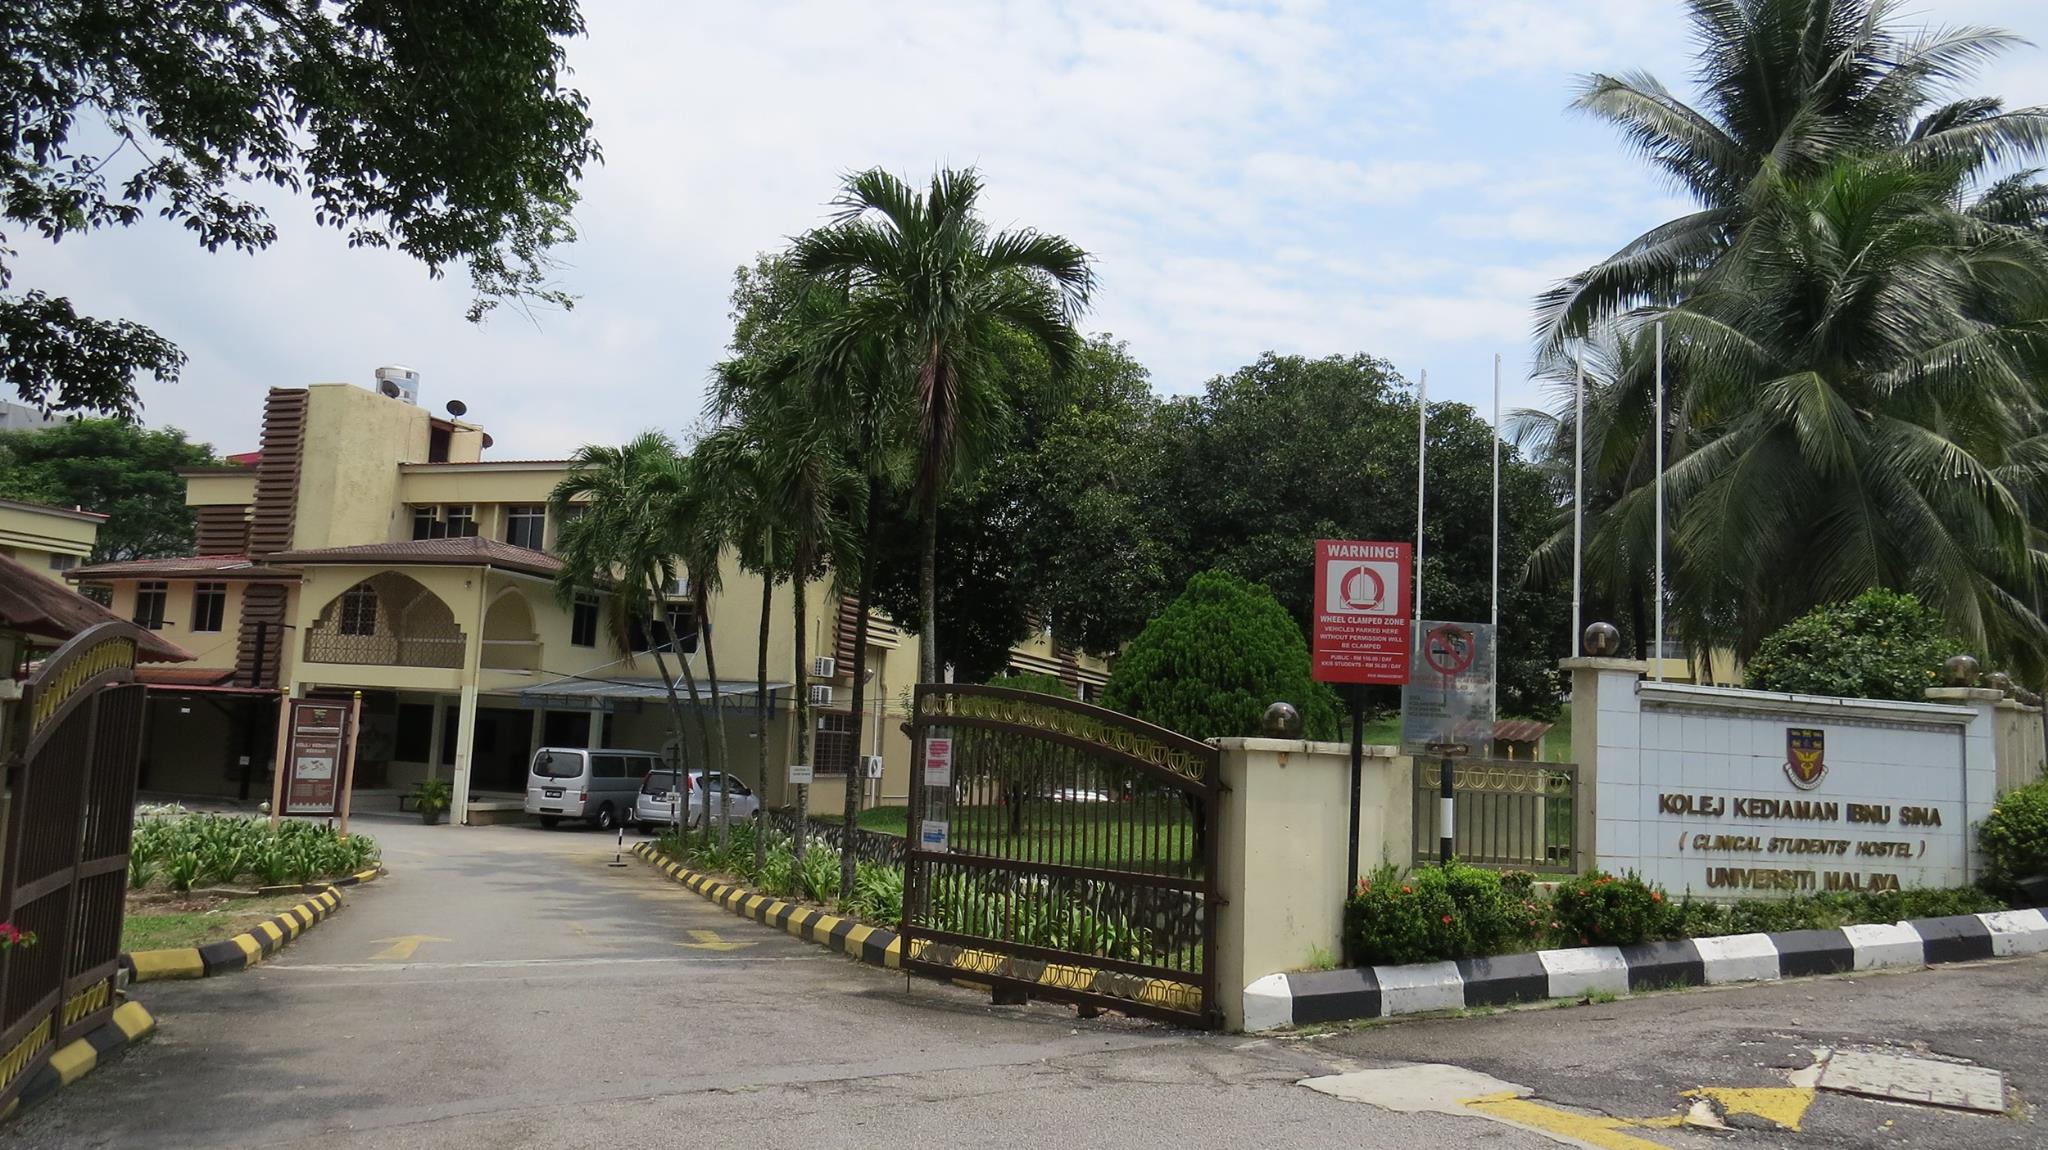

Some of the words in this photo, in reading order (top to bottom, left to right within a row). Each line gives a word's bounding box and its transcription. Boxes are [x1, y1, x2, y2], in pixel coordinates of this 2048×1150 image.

[1327, 545, 1399, 558] WARNING!
[1320, 615, 1346, 624] WHEEL
[1347, 616, 1382, 625] CLAMPED
[1384, 618, 1405, 626] ZONE
[1659, 794, 1725, 817] KOLEJ
[1733, 797, 1839, 821] KEDIAMAN
[1846, 803, 1891, 824] IBNU
[1898, 806, 1942, 827] SINA
[1693, 833, 1763, 852] CLINICAL
[1767, 837, 1851, 855] STUDENTS'
[1855, 841, 1913, 857] HOSTEL
[1706, 867, 1816, 890] UNIVERSITI
[1823, 871, 1901, 892] MALAYA
